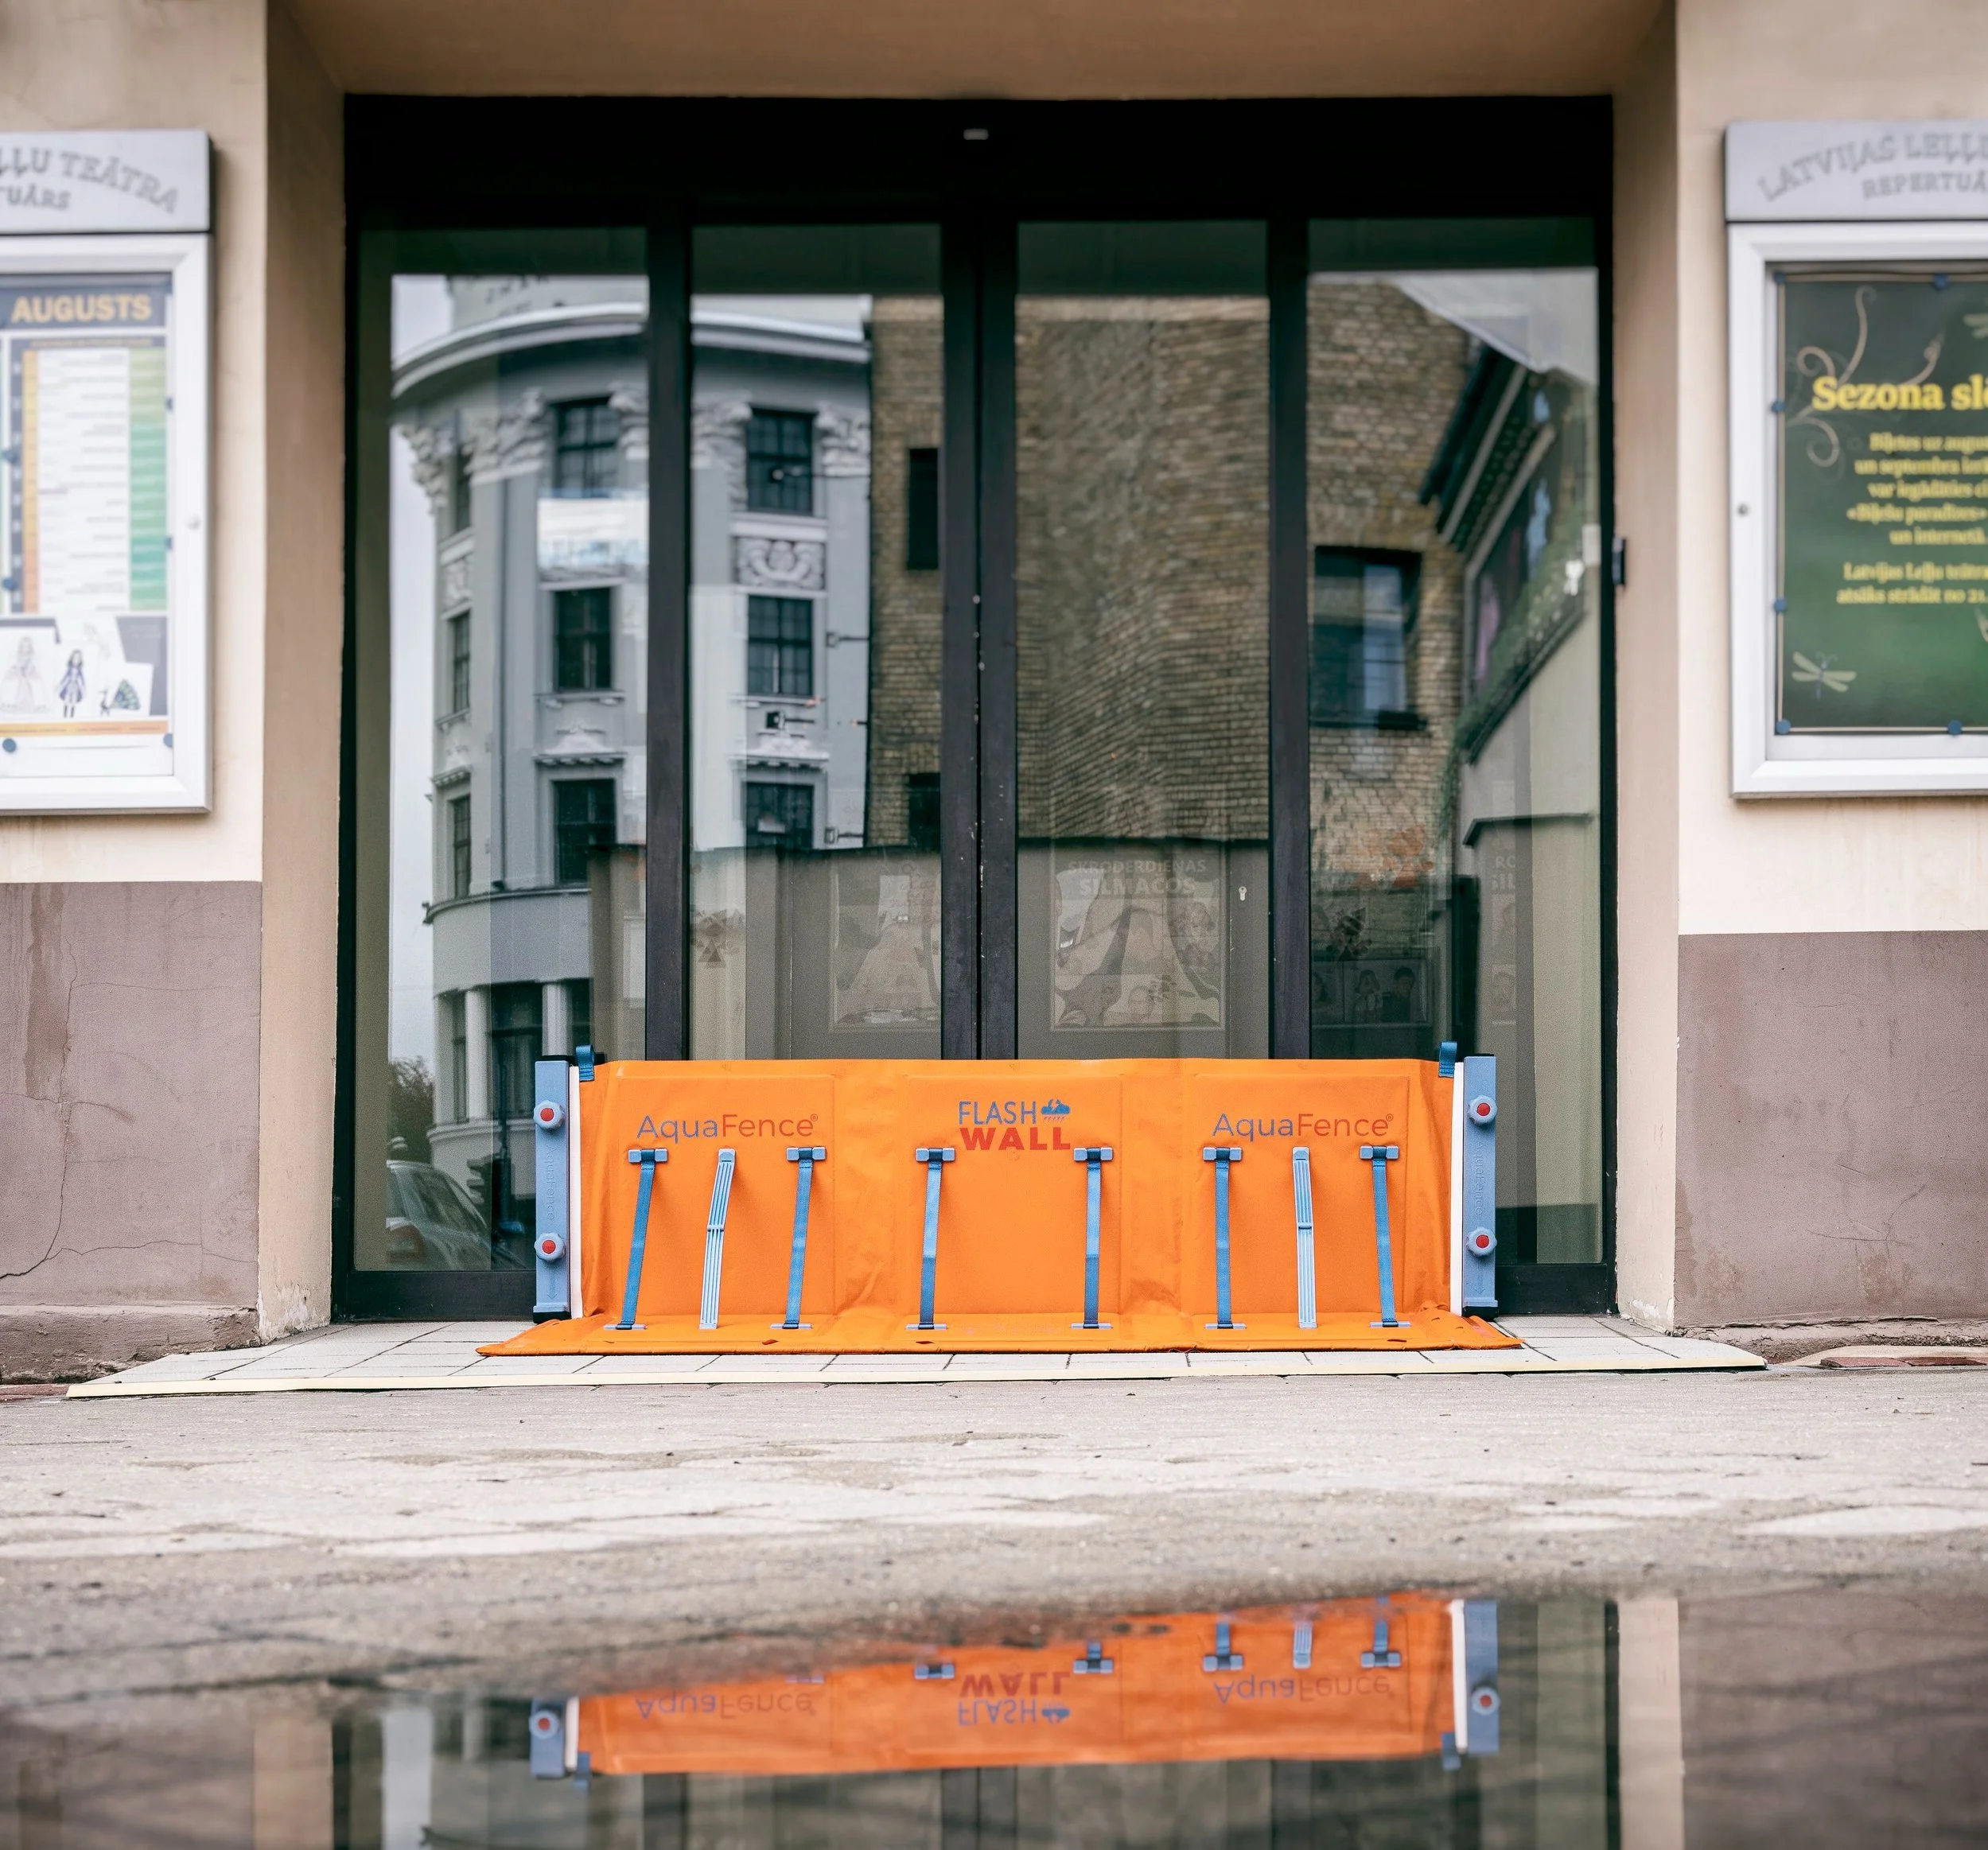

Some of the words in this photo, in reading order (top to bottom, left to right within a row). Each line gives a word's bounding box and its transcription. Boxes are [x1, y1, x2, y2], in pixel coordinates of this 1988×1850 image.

[10, 294, 152, 324] AUGUSTS
[1812, 375, 1946, 410] Sezona
[958, 1100, 1037, 1125] FLASH
[959, 1127, 1071, 1151] WALL
